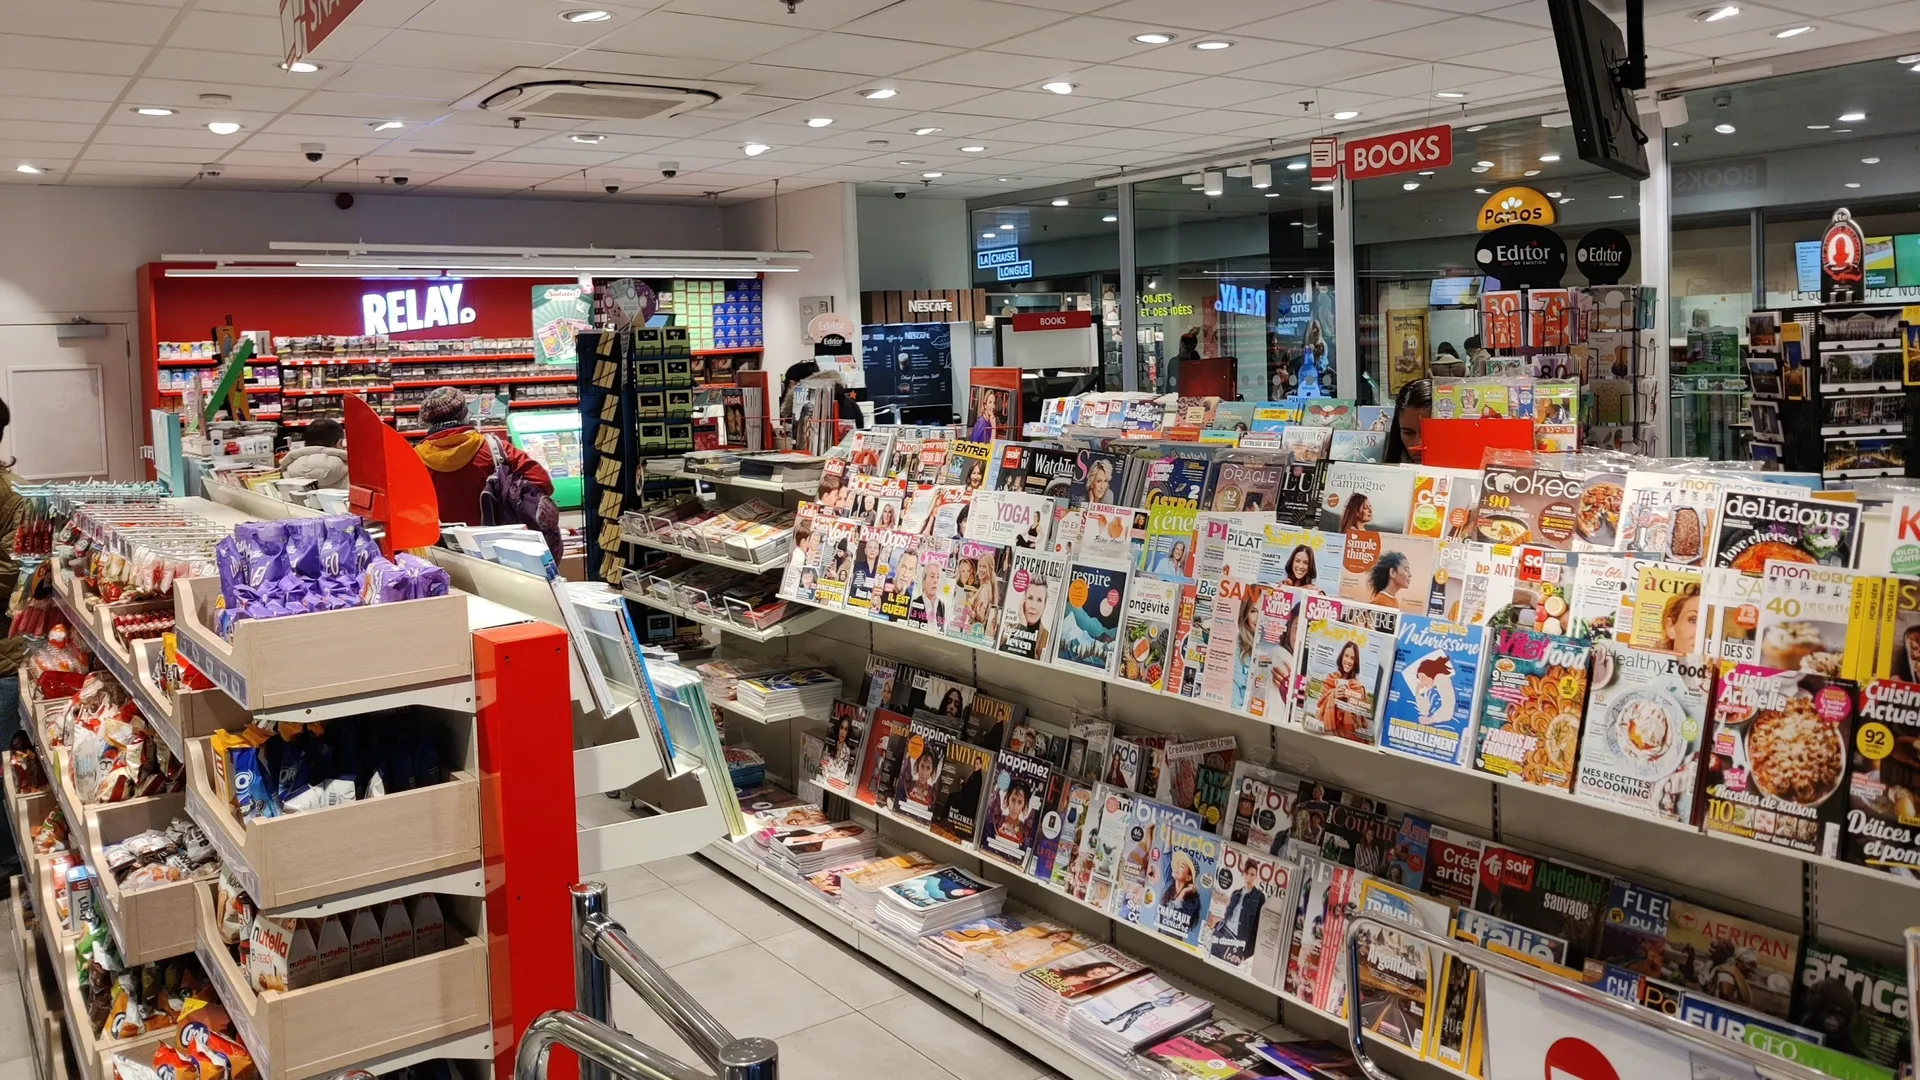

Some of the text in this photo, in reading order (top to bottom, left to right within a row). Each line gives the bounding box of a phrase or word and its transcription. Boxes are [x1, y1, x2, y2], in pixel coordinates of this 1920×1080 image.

[1353, 135, 1441, 172] BOOKS
[1484, 206, 1543, 225] Panos
[979, 251, 1017, 266] LA CHAISE
[1497, 244, 1551, 262] Editor
[1589, 247, 1623, 263] Editor
[1000, 263, 1030, 277] LONGUE
[1142, 293, 1173, 304] OBJETS
[1290, 292, 1312, 304] 100
[362, 283, 465, 336] RELAY
[1140, 303, 1193, 317] ET DES IDÉES
[1290, 304, 1310, 313] ans
[818, 320, 846, 331] Editor
[1040, 316, 1066, 326] BOOKS
[823, 337, 844, 345] Editor
[1364, 435, 1378, 446] 58
[1330, 479, 1386, 492] campagne
[1633, 488, 1659, 506] THE
[997, 502, 1030, 525] YOGA
[1726, 495, 1850, 529] delicious
[1347, 538, 1377, 552] simple
[1747, 529, 1798, 546] cheese
[1346, 549, 1375, 563] things
[1723, 541, 1748, 563] love
[1072, 569, 1112, 589] respire
[896, 594, 910, 604] EST
[1265, 596, 1291, 617] Santé
[1317, 598, 1330, 608] TOP
[1766, 597, 1800, 618] 40
[882, 602, 908, 617] GUÉRI
[1307, 602, 1338, 620] Santé
[1004, 626, 1038, 641] gezond
[1006, 637, 1032, 651] leven
[1499, 629, 1551, 660] Vital
[1724, 645, 1742, 658] DES
[1723, 667, 1782, 691] Cuisine
[1719, 688, 1787, 713] Actuelle
[1865, 729, 1885, 746] 92
[998, 749, 1050, 779] happinez
[1582, 766, 1651, 789] MES RECETTES
[1581, 777, 1650, 800] COCOONING
[1708, 798, 1735, 823] 110
[1716, 784, 1818, 819] Recettes de saison
[1847, 809, 1911, 843] Délices
[1173, 845, 1215, 866] creative
[1223, 845, 1289, 890] burda
[1505, 857, 1532, 876] soir
[944, 868, 979, 889] respire
[1258, 880, 1287, 900] style
[1543, 892, 1589, 920] sauvage
[384, 928, 412, 943] nutella
[416, 921, 443, 935] nutella
[252, 922, 288, 959] nutella
[352, 937, 381, 951] nutella
[288, 953, 317, 969] nutella
[319, 945, 348, 961] nutella
[1367, 942, 1417, 981] Argentina
[1807, 947, 1832, 961] travel
[1803, 955, 1910, 1019] africa
[1749, 1032, 1798, 1060] GEO
